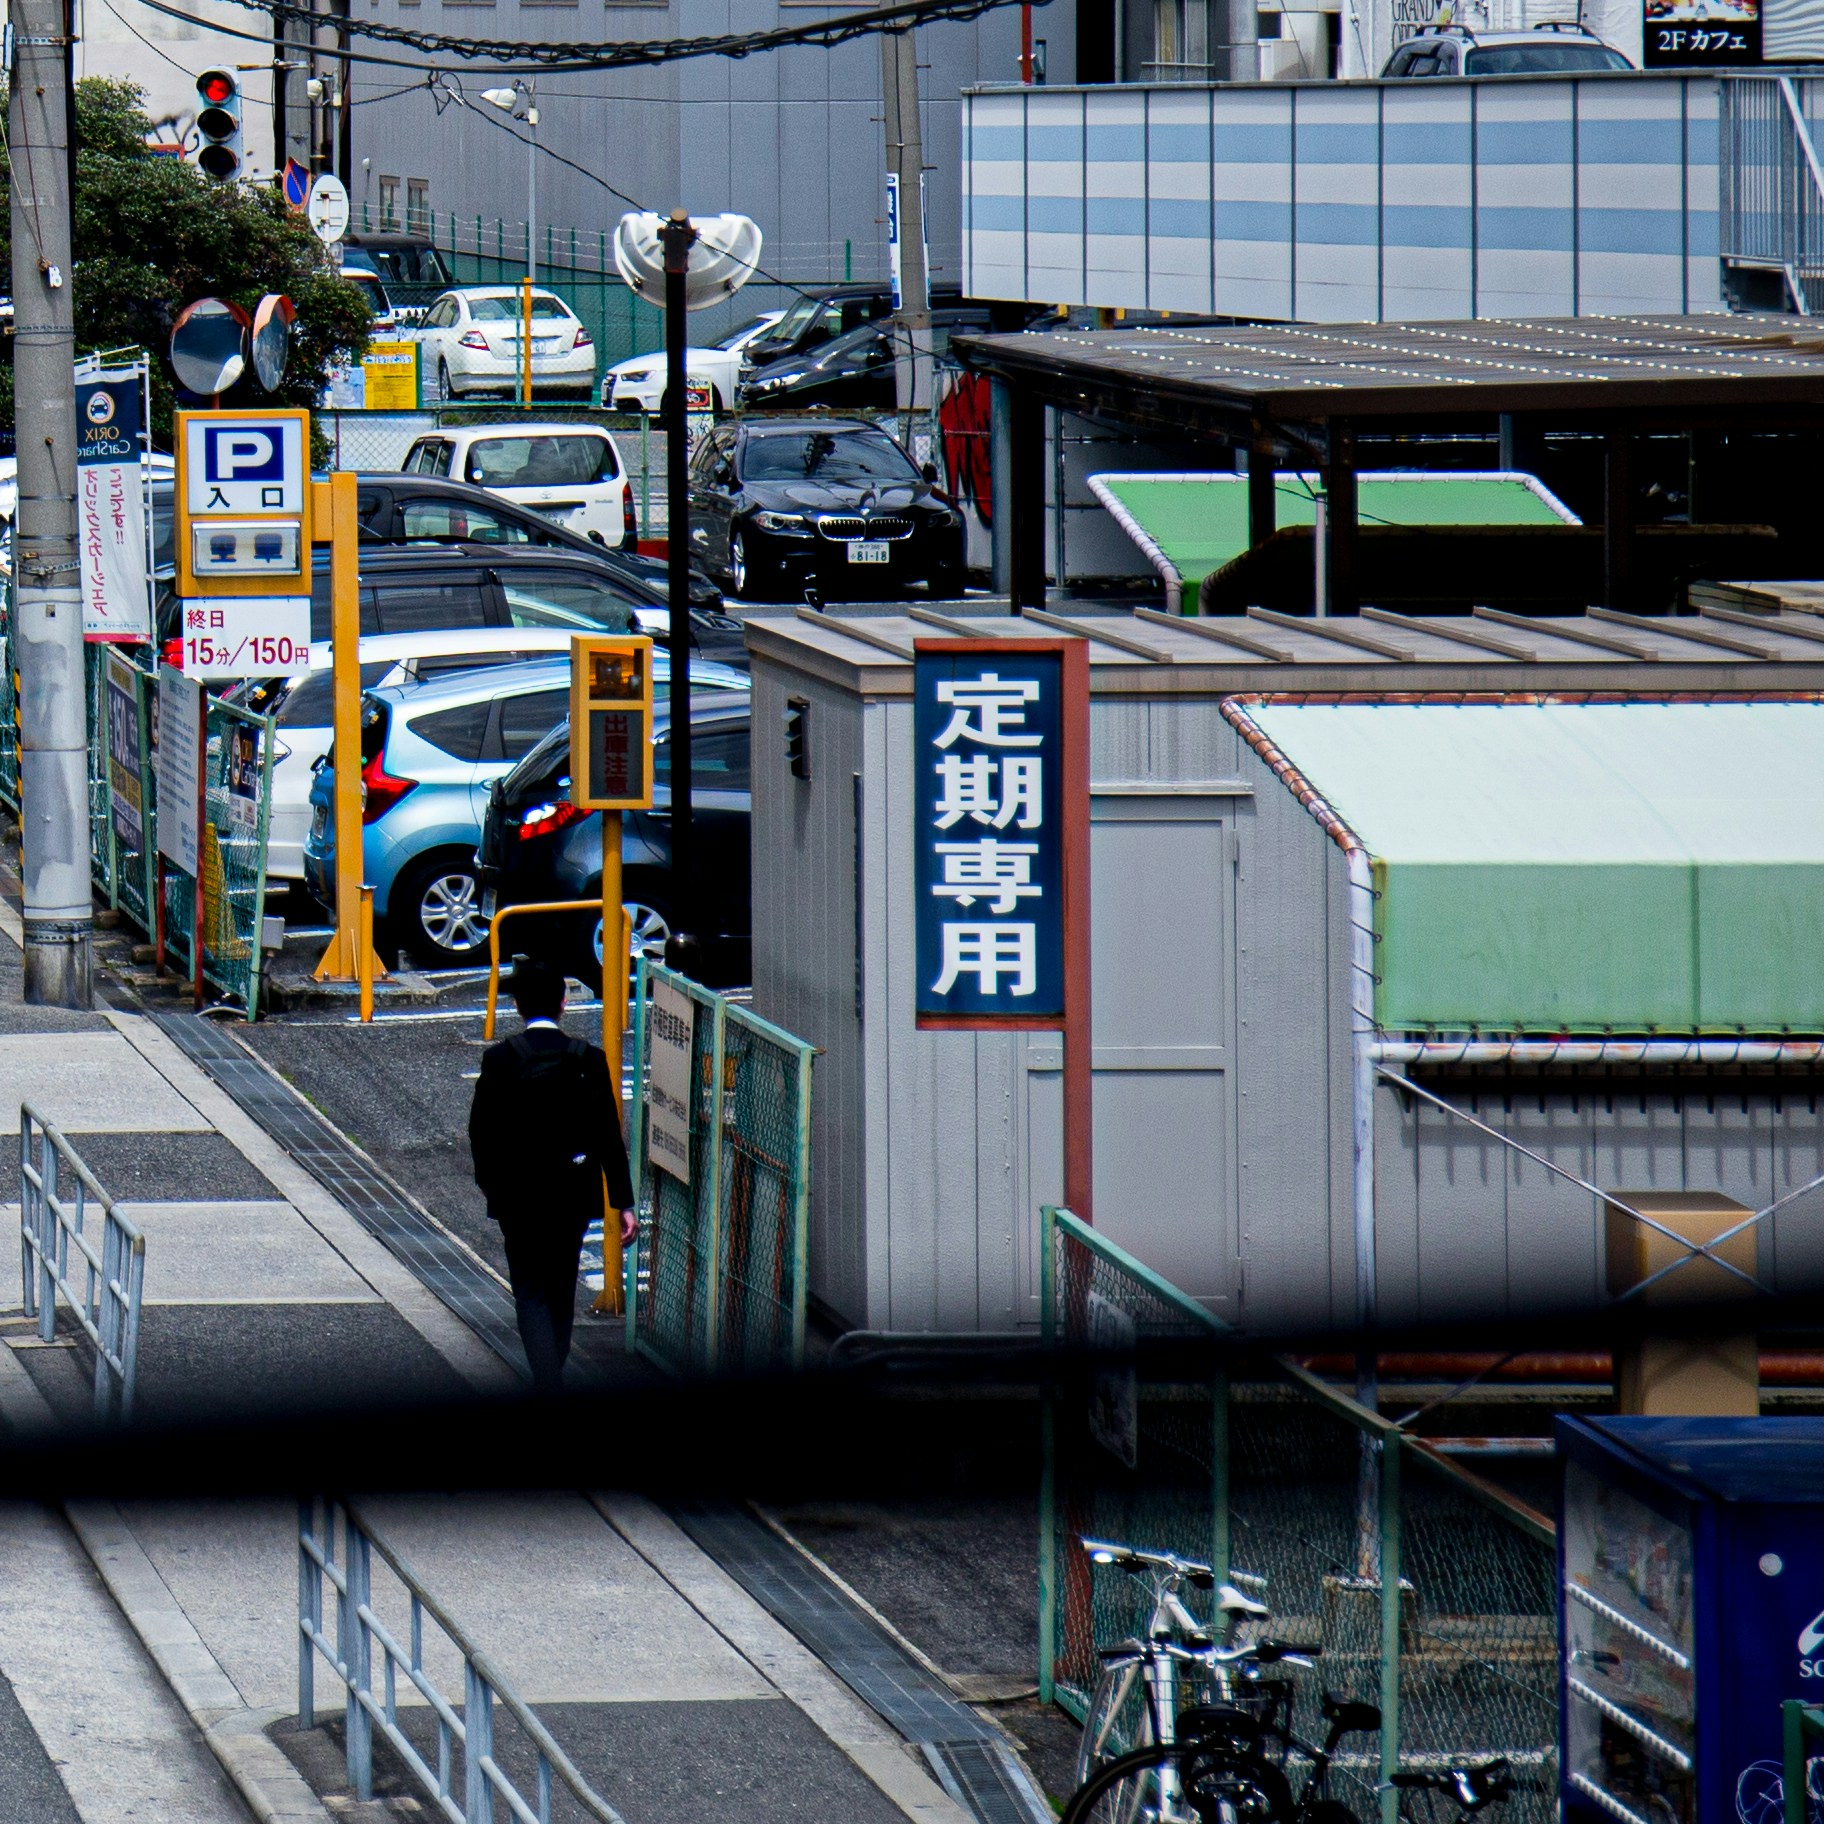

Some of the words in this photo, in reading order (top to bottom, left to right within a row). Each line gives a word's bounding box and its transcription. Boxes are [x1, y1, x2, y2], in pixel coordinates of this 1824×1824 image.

[1658, 30, 1687, 50] 2F
[1690, 30, 1747, 51] カフェ
[216, 431, 274, 479] P
[206, 486, 284, 509] 入口
[857, 550, 887, 562] 81-18
[186, 609, 225, 630] 終日
[931, 673, 1046, 999] 定期専用
